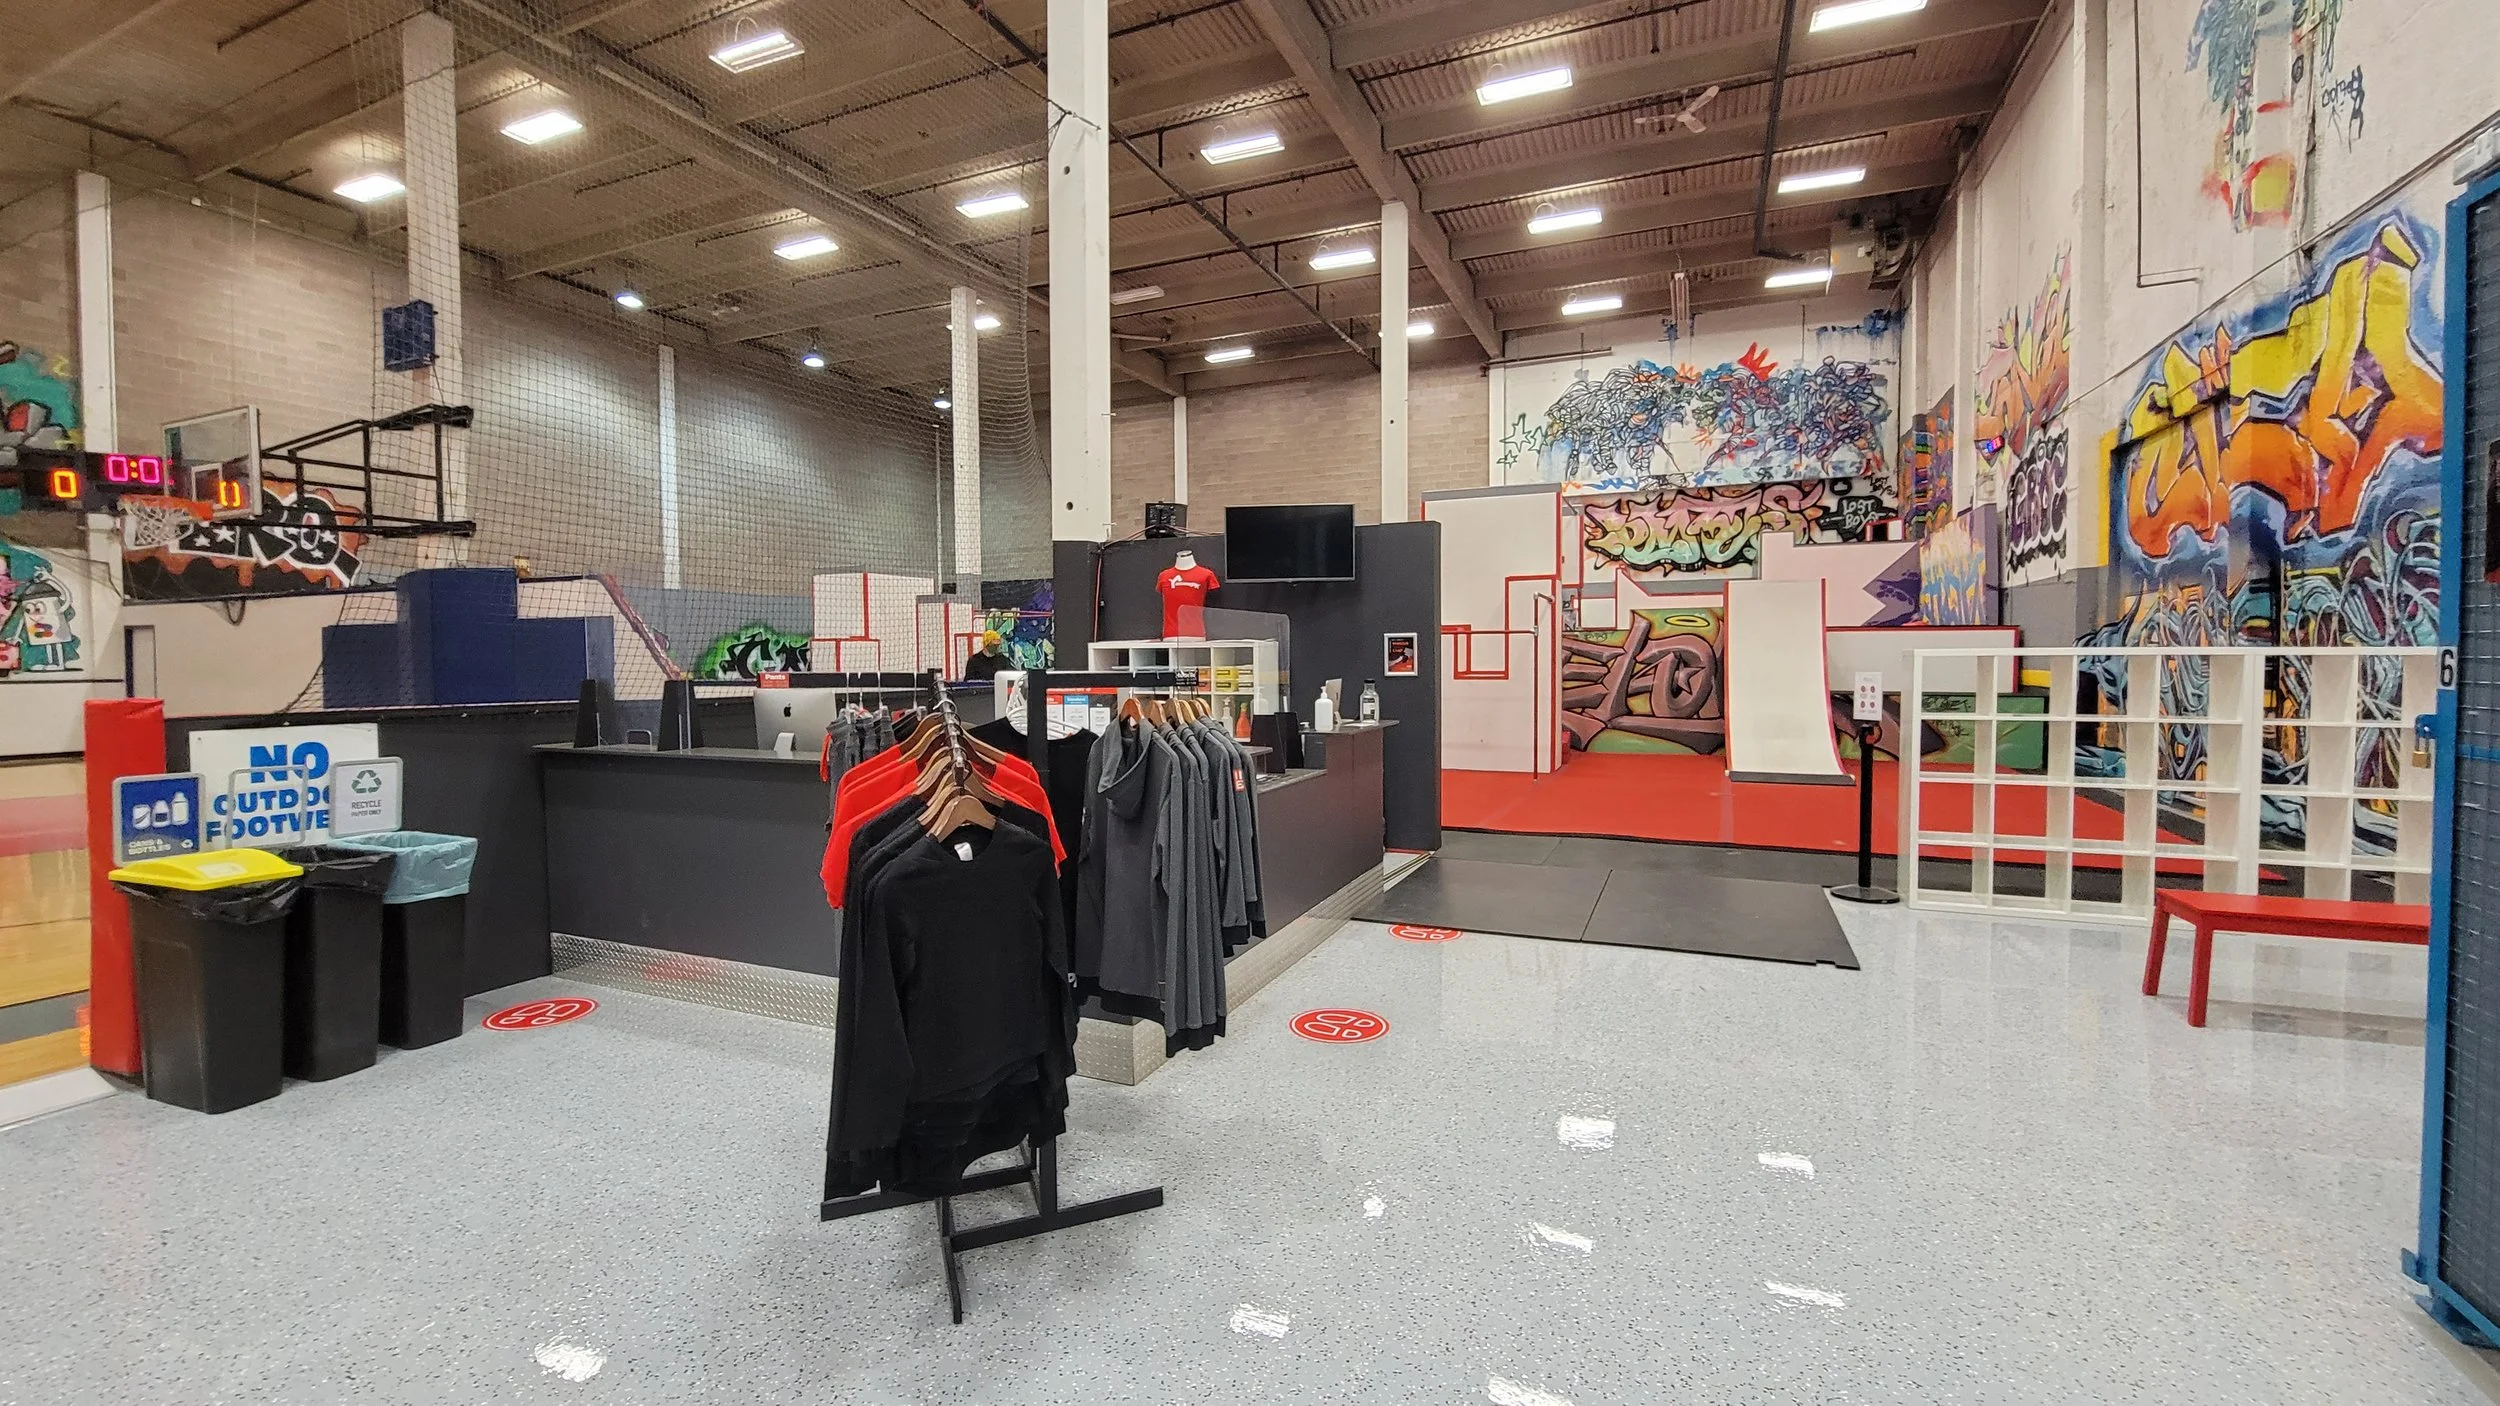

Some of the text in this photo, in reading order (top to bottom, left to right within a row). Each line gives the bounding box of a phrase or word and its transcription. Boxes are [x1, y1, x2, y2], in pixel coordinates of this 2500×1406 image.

[54, 470, 77, 499] 0
[1842, 500, 1875, 515] LOST
[2441, 649, 2454, 687] 6
[250, 742, 330, 784] NO
[213, 785, 329, 816] OUTDO
[351, 800, 382, 809] RECYCLE
[206, 809, 329, 842] FOOTWE
